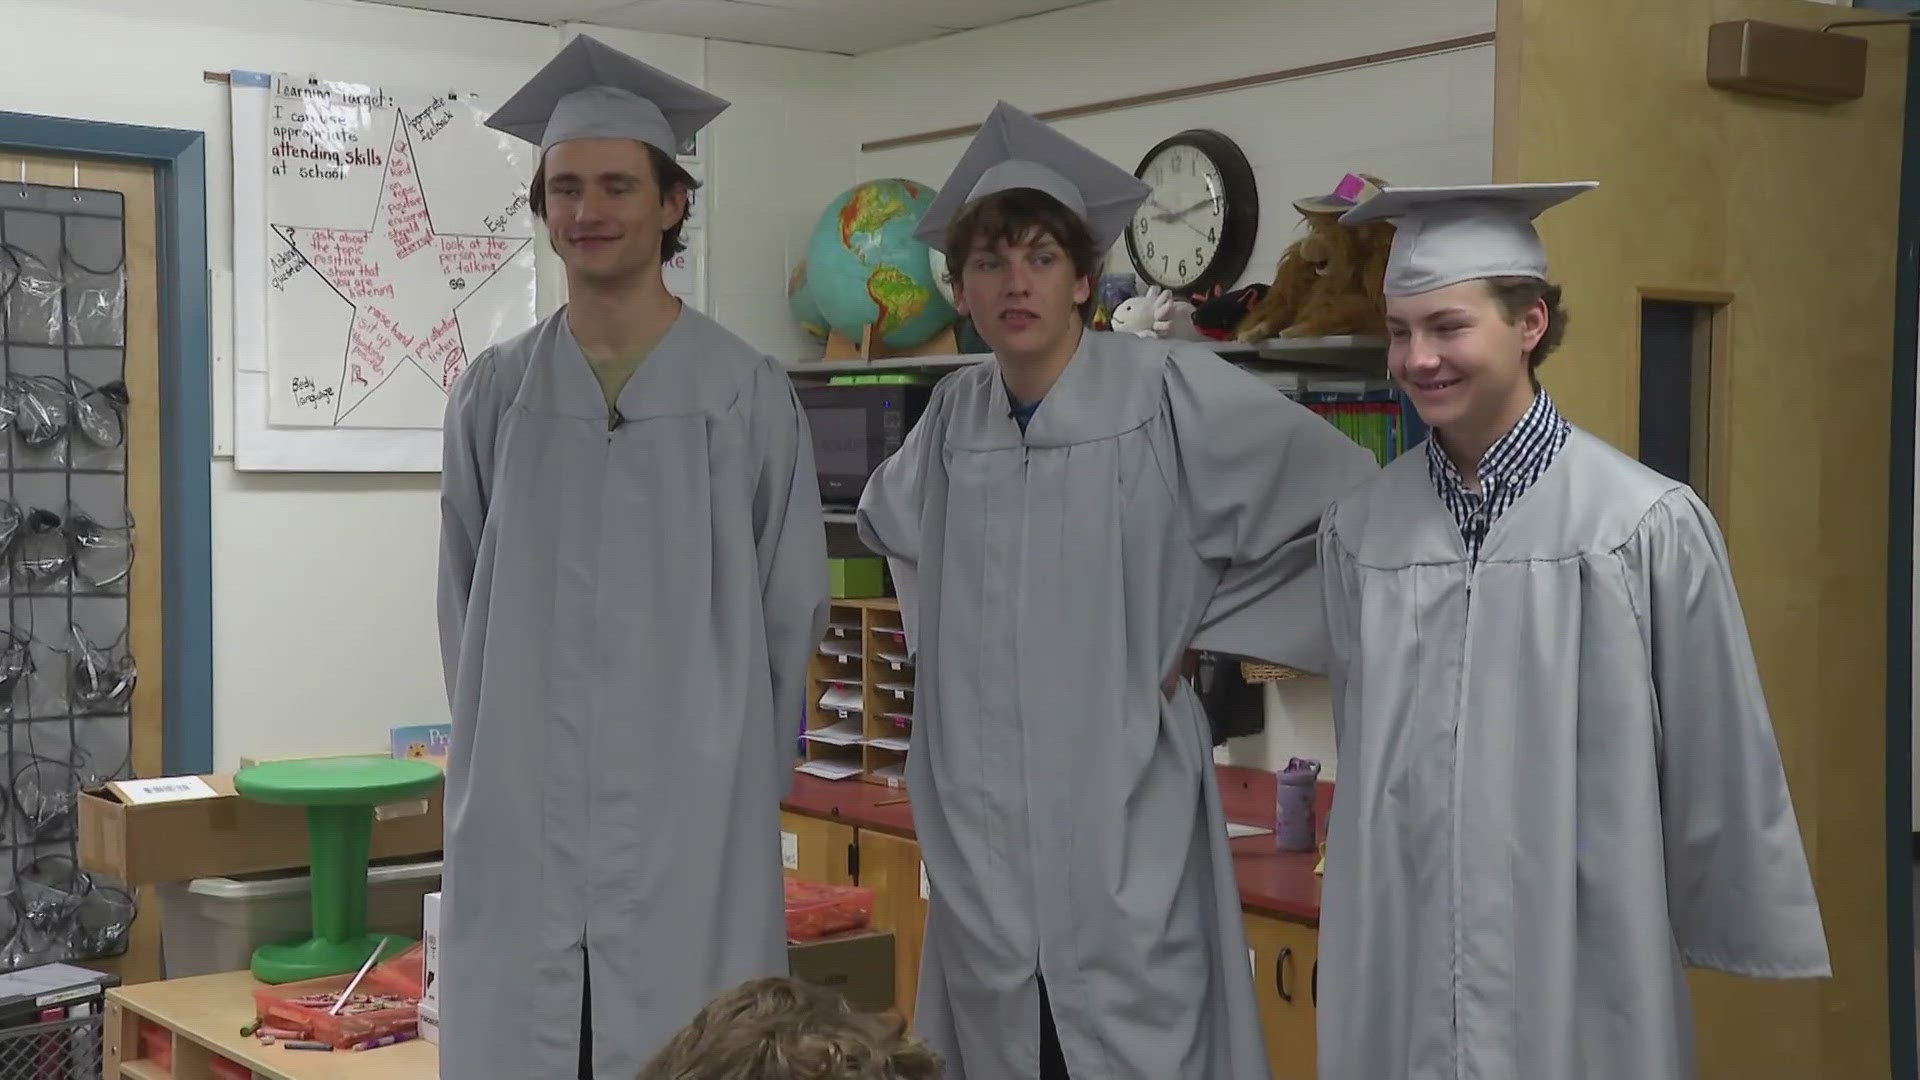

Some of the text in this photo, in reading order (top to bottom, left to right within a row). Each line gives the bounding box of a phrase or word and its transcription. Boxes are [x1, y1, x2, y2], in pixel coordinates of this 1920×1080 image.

[276, 78, 331, 111] Learning
[273, 105, 284, 119] I
[271, 141, 382, 166] attending skills
[272, 160, 287, 175] at
[483, 215, 508, 233] Eye
[1140, 217, 1149, 235] 9
[312, 229, 368, 243] ask about
[441, 236, 509, 251] look at the
[1207, 227, 1217, 245] 4
[311, 240, 364, 257] the topic
[1146, 241, 1156, 259] 8
[314, 254, 362, 266] positive
[439, 252, 476, 265] person
[1161, 255, 1169, 273] 7
[1195, 248, 1204, 267] 5
[327, 262, 380, 278] show that
[456, 262, 498, 275] talking
[1178, 259, 1187, 278] 6
[333, 279, 373, 292] you are
[349, 284, 394, 300] listening
[376, 333, 392, 350] up
